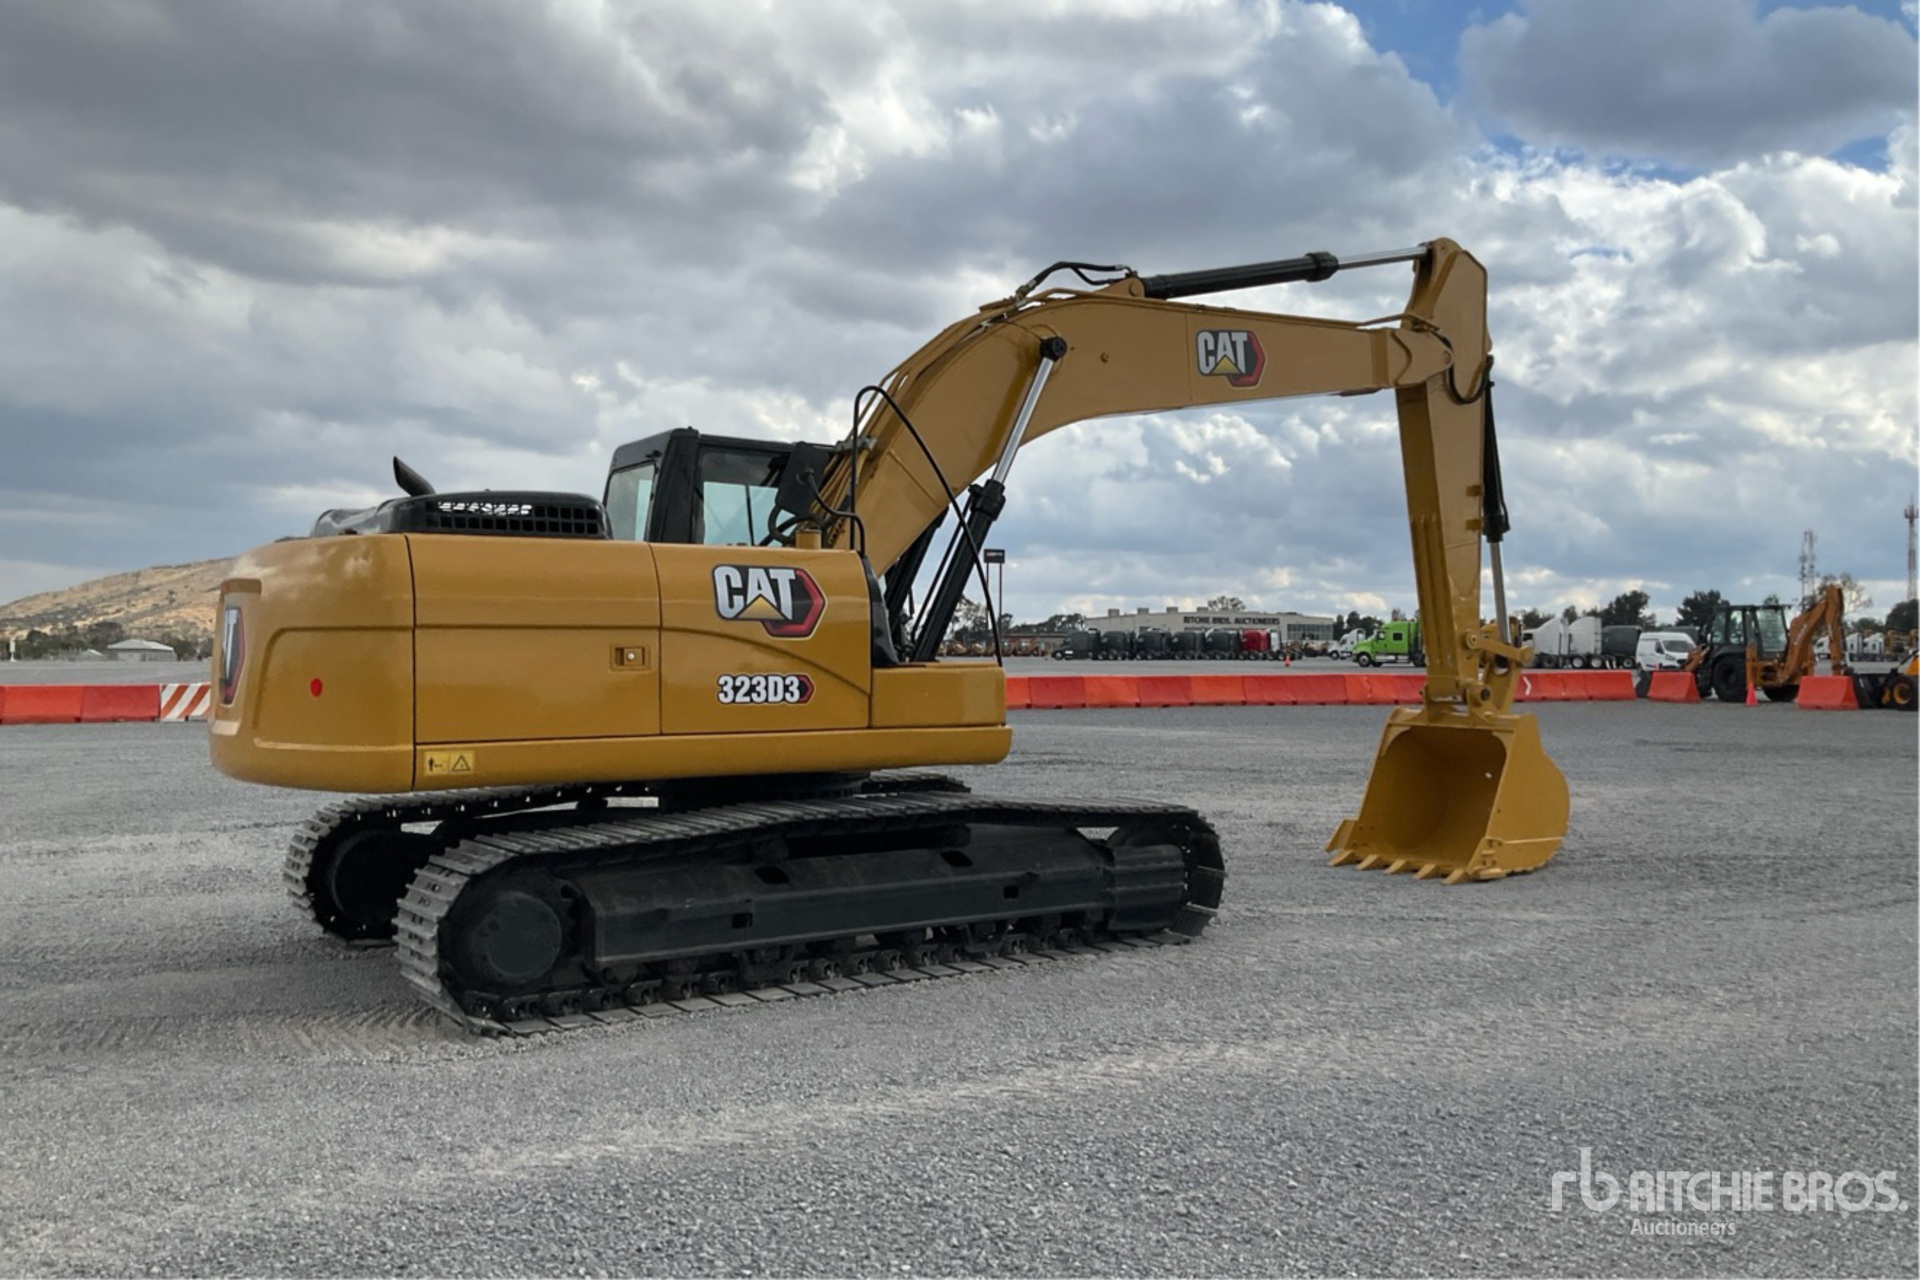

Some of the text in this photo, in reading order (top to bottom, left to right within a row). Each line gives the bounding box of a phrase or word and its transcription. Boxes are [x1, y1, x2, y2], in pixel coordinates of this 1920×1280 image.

[1197, 331, 1248, 374] CAT
[714, 566, 796, 620] CAT
[718, 675, 800, 703] 323D3
